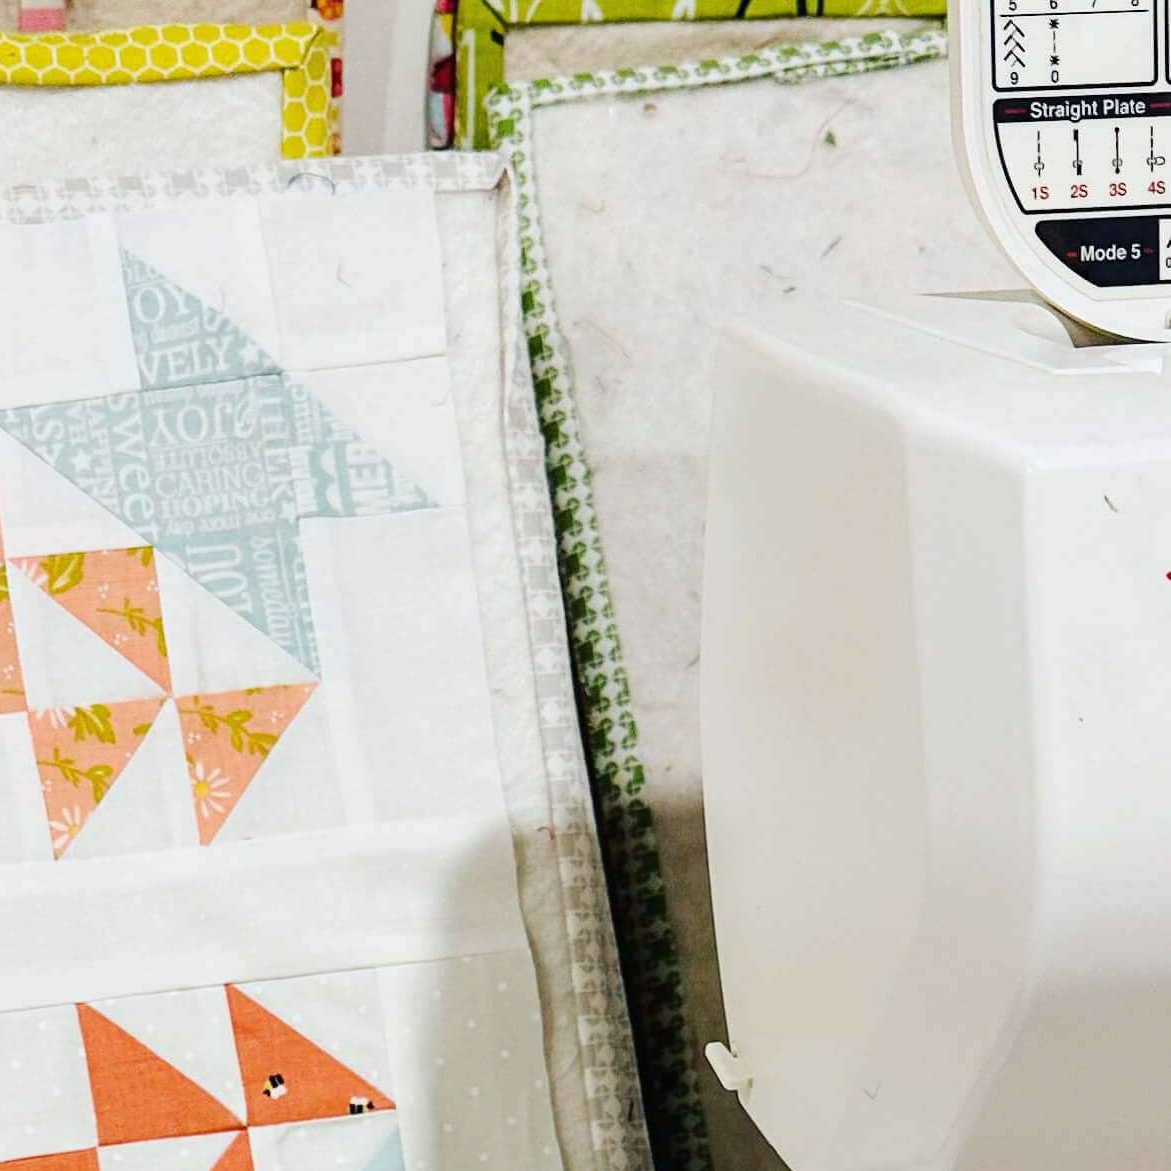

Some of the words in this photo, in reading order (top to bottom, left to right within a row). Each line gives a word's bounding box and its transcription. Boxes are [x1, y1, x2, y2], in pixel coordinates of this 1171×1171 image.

[1010, 71, 1019, 85] 9
[1051, 70, 1059, 83] 0
[1030, 100, 1098, 120] Straight
[1102, 99, 1146, 116] Plate
[1031, 186, 1049, 200] 1S
[1070, 184, 1088, 198] 2S
[1109, 182, 1127, 196] 3S
[1147, 180, 1166, 195] 4S
[1080, 244, 1127, 262] Mode
[1131, 243, 1142, 260] 5
[155, 461, 267, 499] CARING
[162, 486, 271, 520] HOPING
